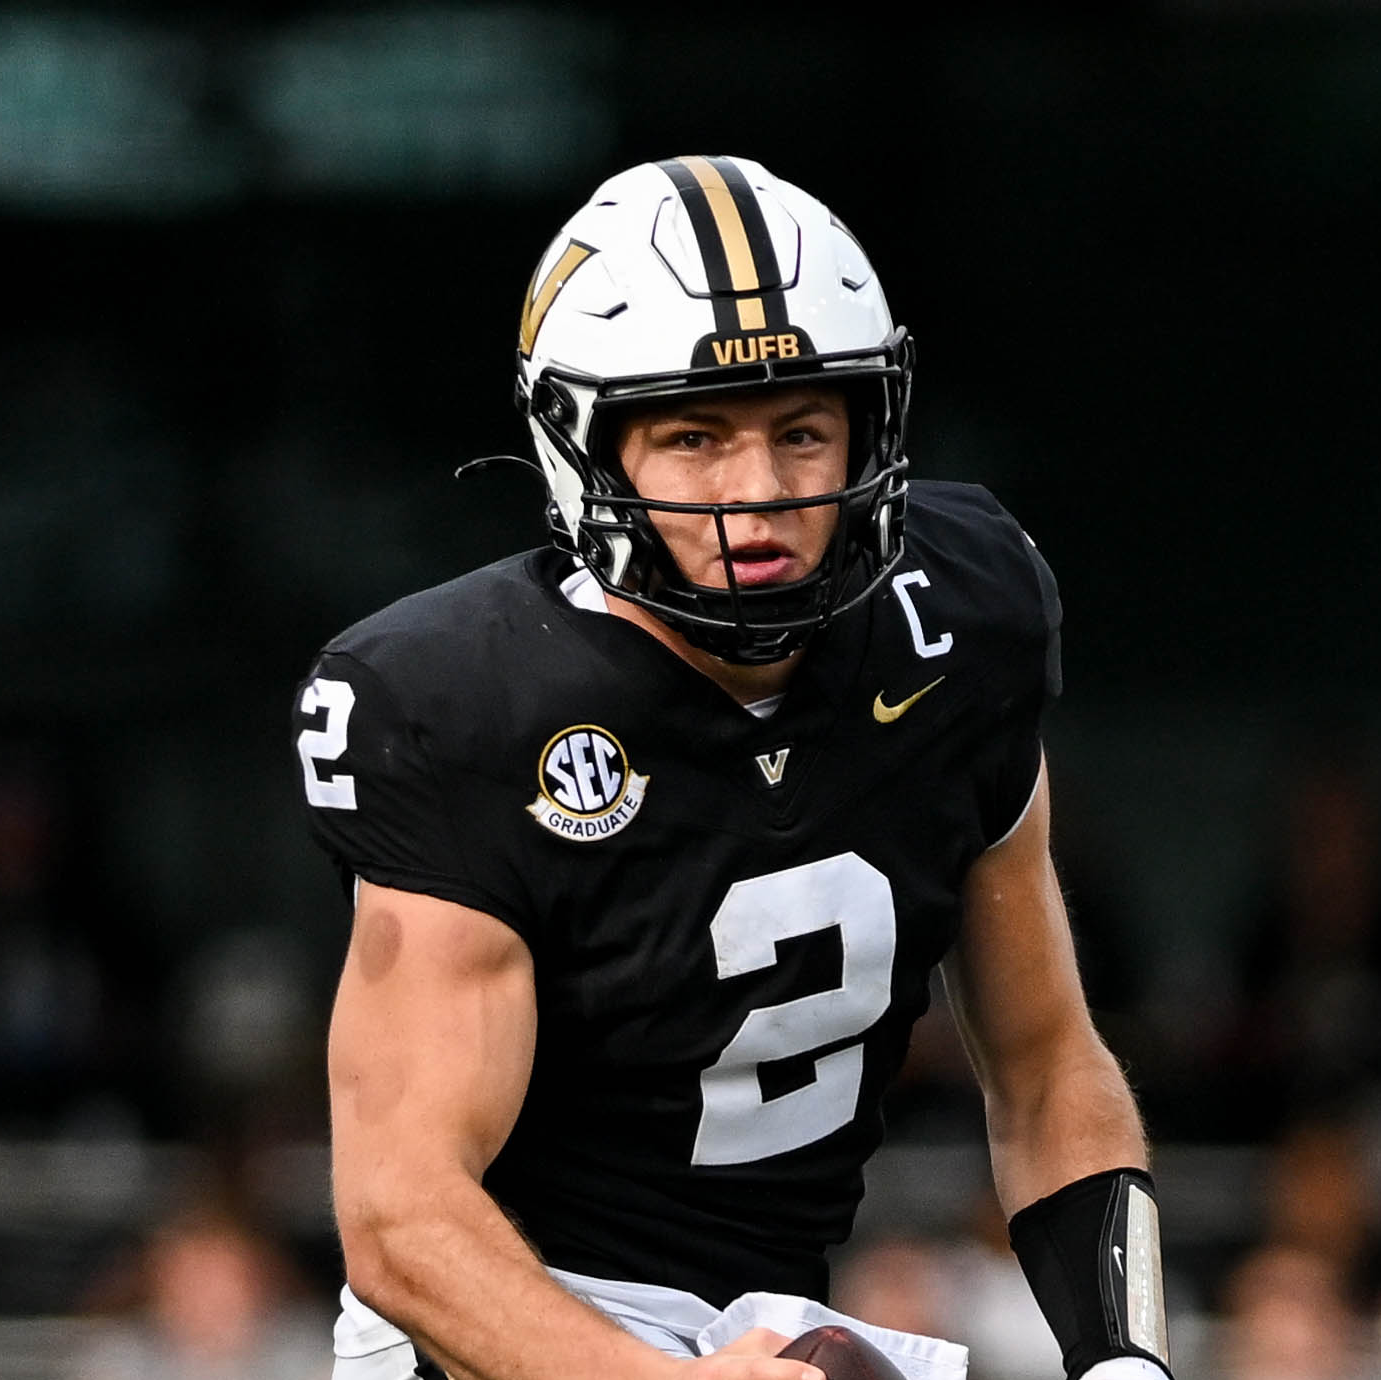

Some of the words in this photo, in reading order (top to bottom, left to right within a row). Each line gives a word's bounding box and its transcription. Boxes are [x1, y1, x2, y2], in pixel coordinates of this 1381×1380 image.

[711, 333, 800, 366] VUFB
[891, 569, 954, 659] C
[297, 677, 358, 811] 2
[545, 732, 621, 811] SEC
[755, 748, 790, 785] V
[548, 794, 638, 837] GRADUATE
[691, 851, 897, 1167] 2
